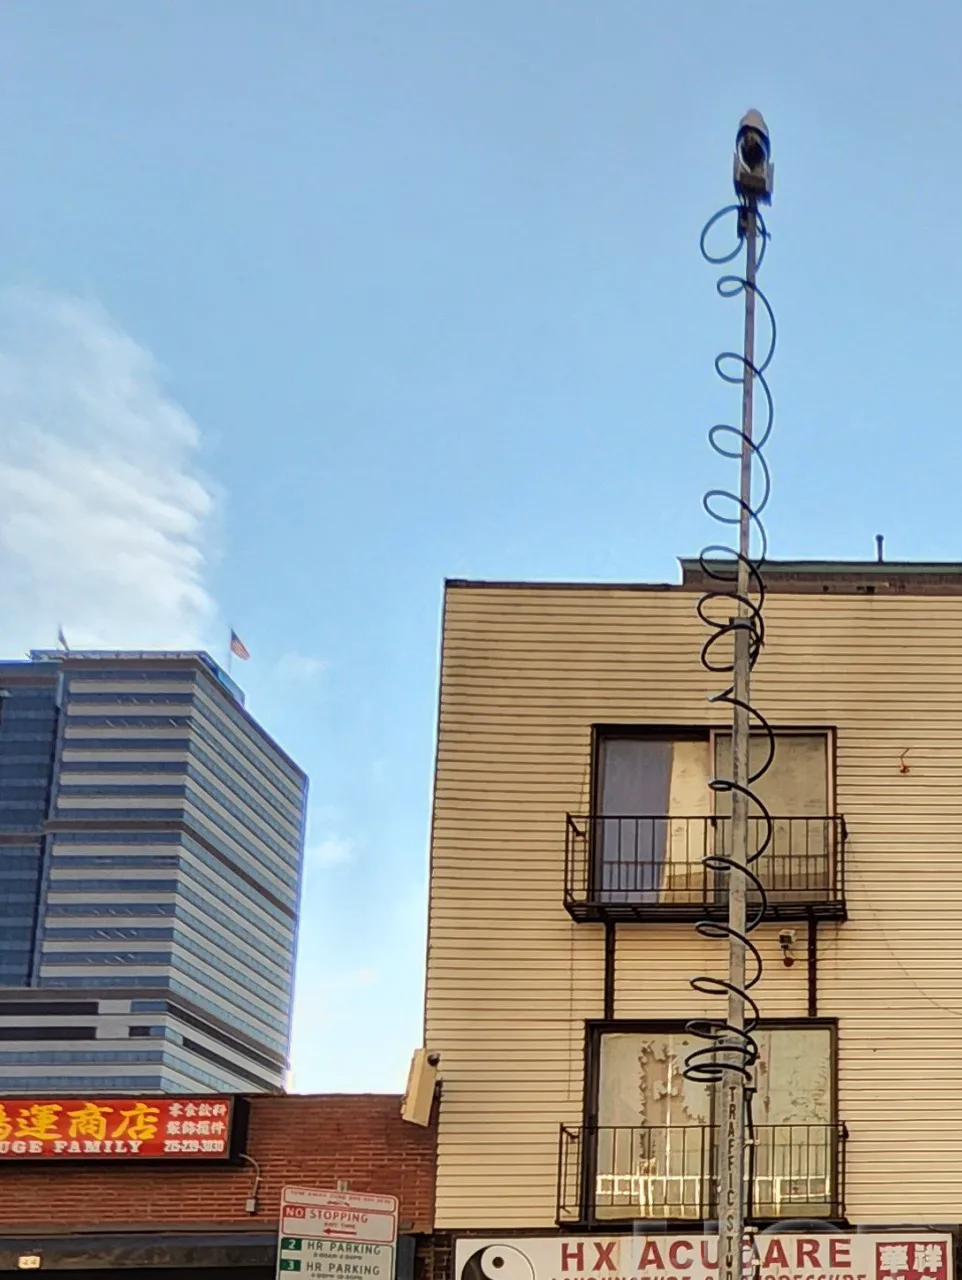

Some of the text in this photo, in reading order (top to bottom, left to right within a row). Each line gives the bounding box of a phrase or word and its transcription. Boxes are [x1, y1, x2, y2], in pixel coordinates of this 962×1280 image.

[0, 1103, 160, 1140] 運商店
[53, 1141, 143, 1153] FAMILY
[726, 1086, 737, 1206] TRAFFIC
[285, 1208, 368, 1223] NO STOPPING
[288, 1240, 381, 1255] 2 HR PARKING
[560, 1241, 617, 1272] HX
[288, 1260, 380, 1275] 3 HR PARKING
